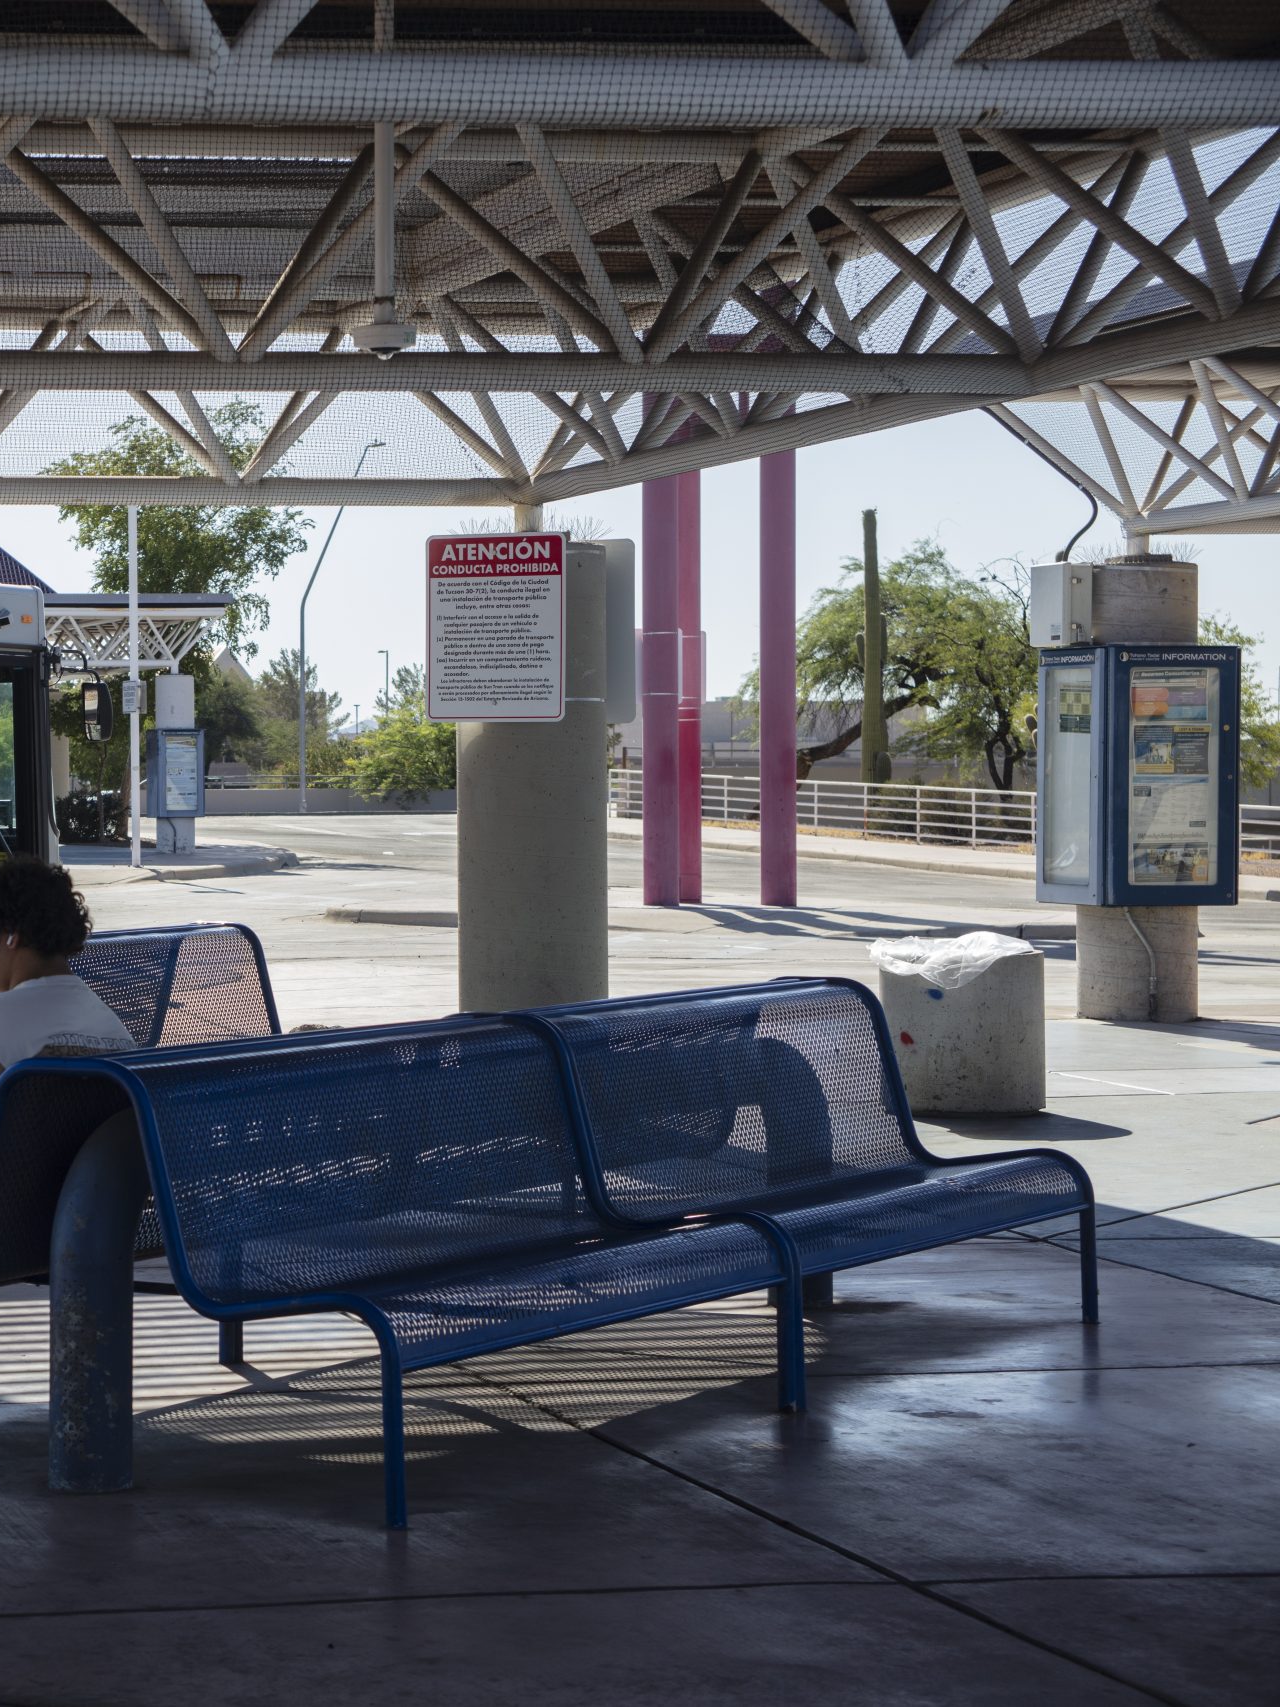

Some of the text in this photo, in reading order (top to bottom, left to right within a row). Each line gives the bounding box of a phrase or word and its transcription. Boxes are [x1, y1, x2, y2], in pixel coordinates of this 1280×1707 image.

[441, 538, 550, 562] ATENCIÓN
[432, 562, 559, 575] CONDUCTA PROHIBIDA
[1061, 654, 1094, 663] INFORMACIÓN
[1162, 653, 1226, 661] INFORMATION
